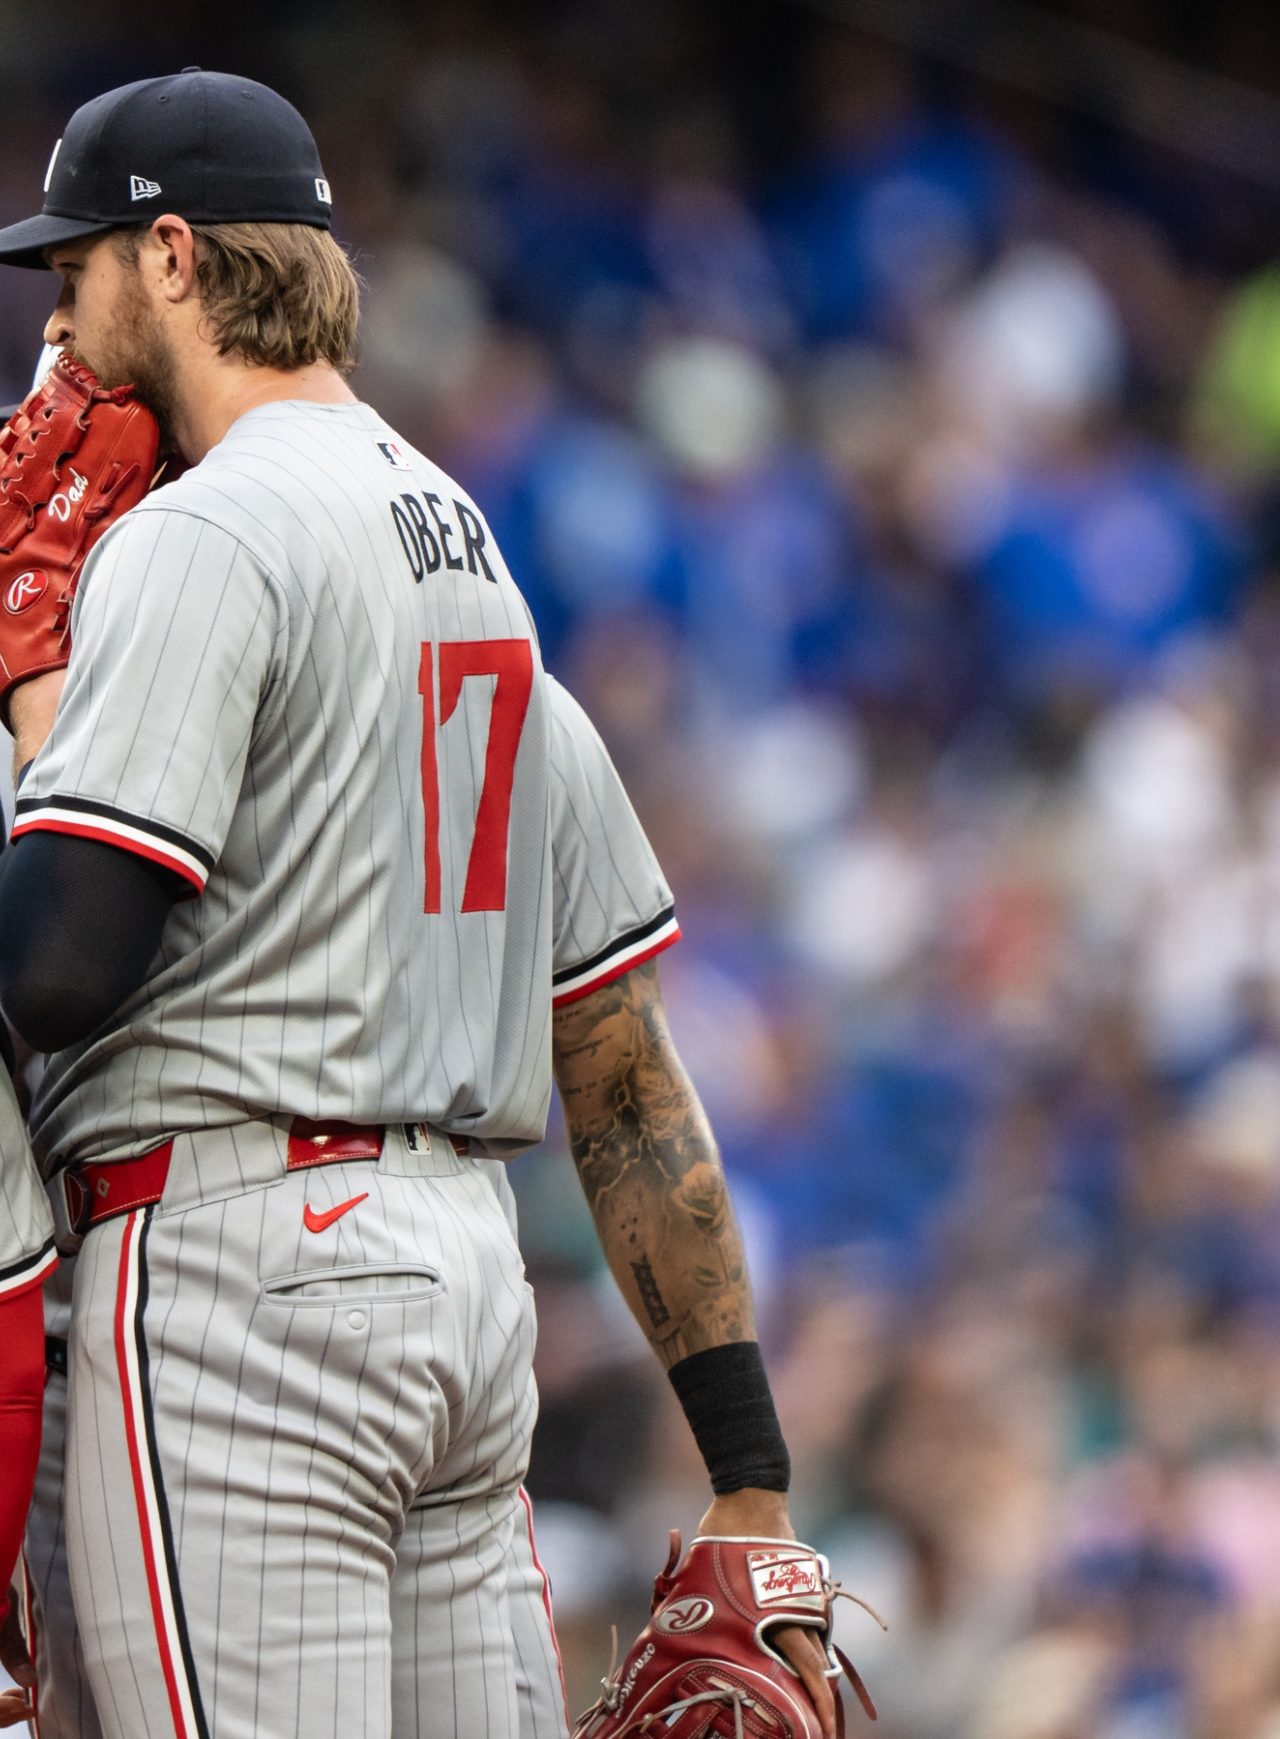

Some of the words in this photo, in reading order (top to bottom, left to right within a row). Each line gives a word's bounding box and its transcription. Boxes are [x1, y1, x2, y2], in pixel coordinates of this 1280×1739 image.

[48, 467, 89, 521] Dad
[389, 490, 498, 584] OBER
[7, 571, 42, 612] R
[417, 638, 534, 914] 17
